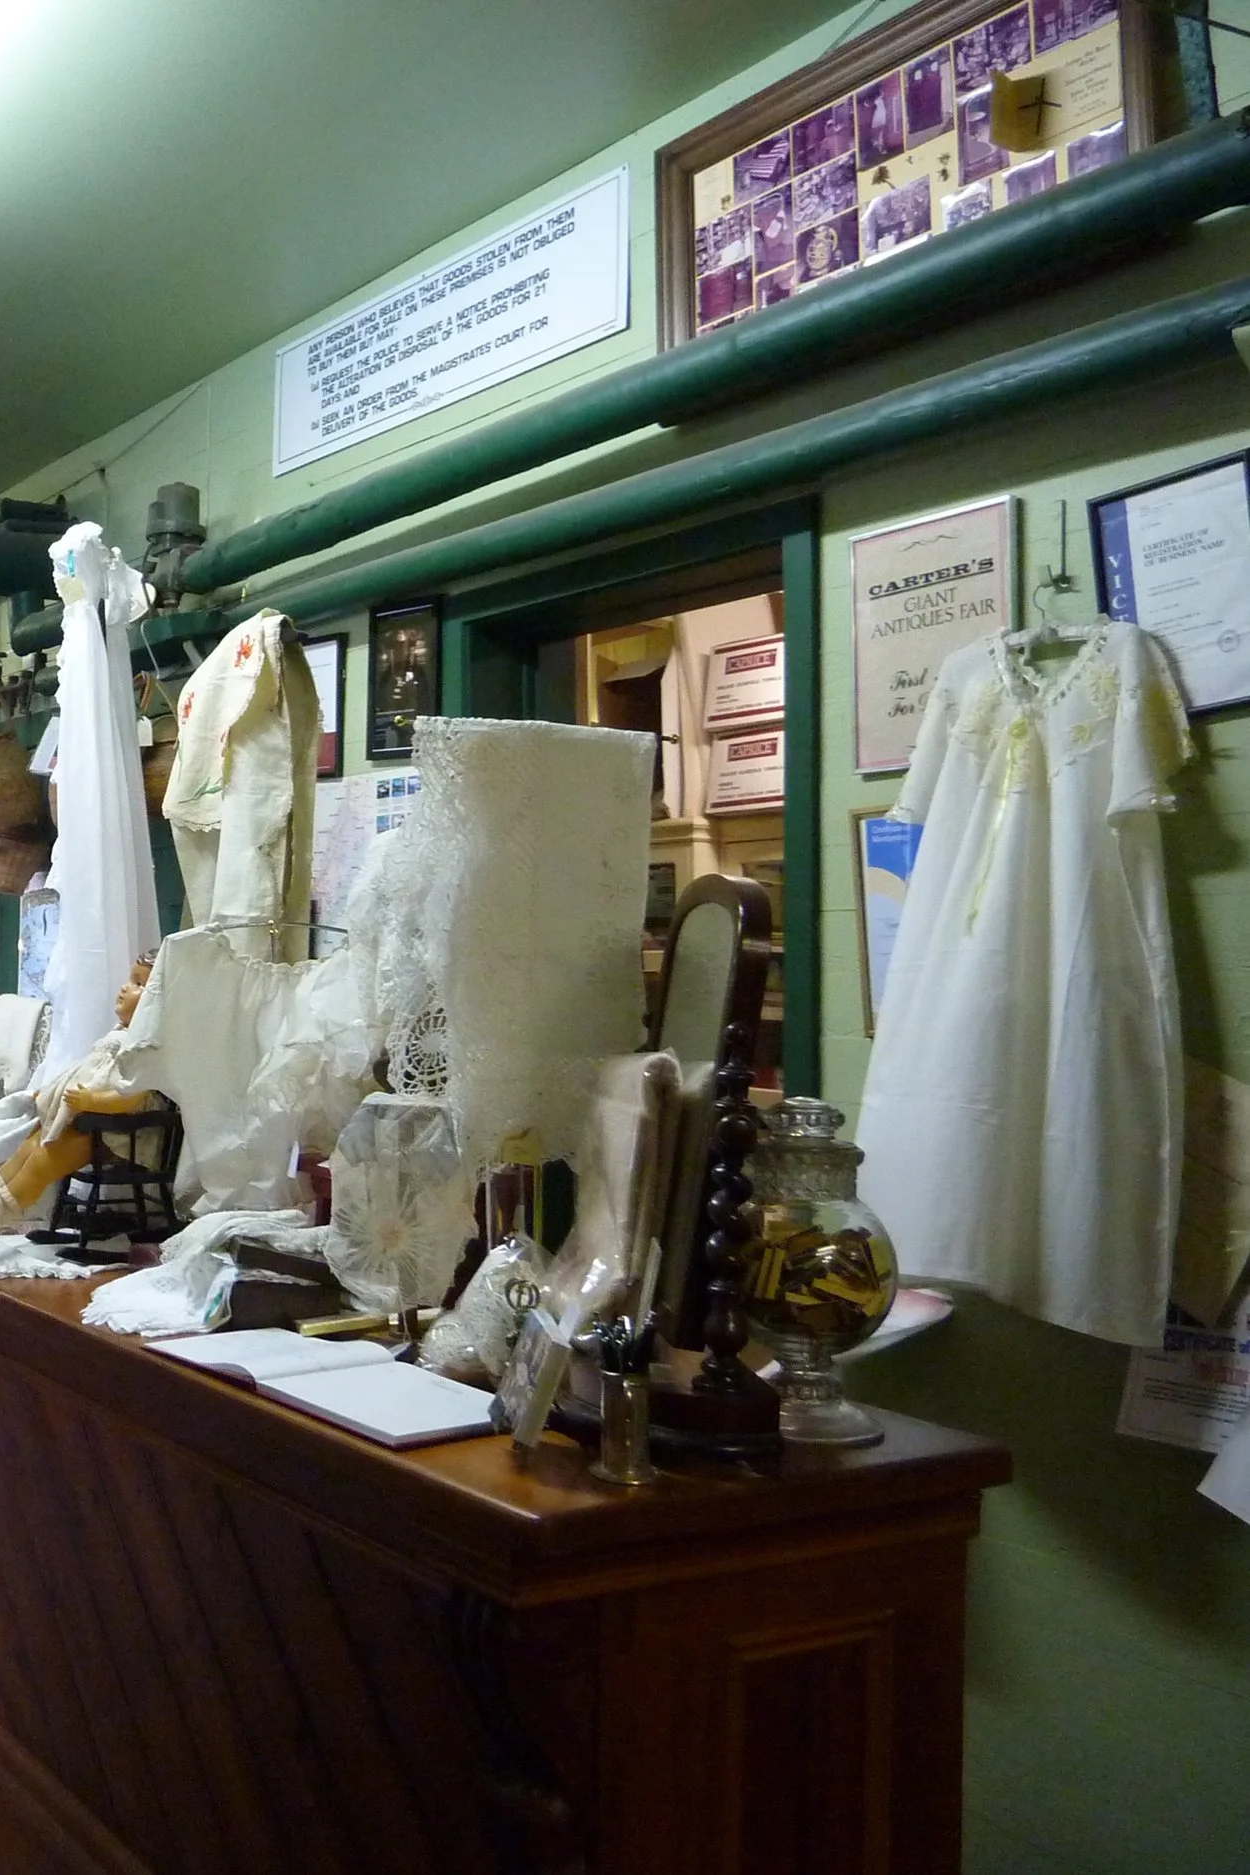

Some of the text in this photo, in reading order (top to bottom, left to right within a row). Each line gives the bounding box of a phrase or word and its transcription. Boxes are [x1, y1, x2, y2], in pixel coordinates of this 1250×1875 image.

[308, 207, 575, 354] ANY PERSON WHO BELIEVES THAT GOODS STOLEN FROM THEM
[308, 221, 575, 366] ARE AVAILABLE FOR SALE ON THESE PREMISES IS NOT OBLIGED
[321, 364, 354, 387] REQUEST
[356, 355, 370, 369] THE
[373, 341, 400, 362] POLICE
[403, 335, 413, 347] TO
[416, 320, 442, 341] SERVE
[446, 316, 453, 327] A
[456, 298, 487, 322] NOTICE
[491, 268, 550, 305] PROHIBITING
[321, 283, 546, 397] THE ALTERATION OR DISPOSAL OF THE GOODS FOR 21
[307, 366, 317, 377] TO
[318, 357, 333, 372] BUY
[336, 345, 357, 363] THEM
[359, 337, 373, 352] BUT
[321, 410, 339, 426] SEEK
[343, 404, 354, 416] AN
[357, 391, 382, 410] ORDER
[385, 379, 409, 397] FROM
[411, 371, 427, 385] THE
[430, 342, 491, 377] MAGISTRATES
[494, 325, 526, 348] COURT
[529, 316, 548, 334] FOR
[321, 384, 360, 409] DAYS AND
[321, 415, 355, 437] DELIVERY
[358, 408, 370, 421] OF
[372, 401, 386, 416] THE
[868, 558, 995, 596] CARTER'S
[871, 598, 997, 640] ANTIQUES FAIR
[903, 586, 958, 613] GIANT
